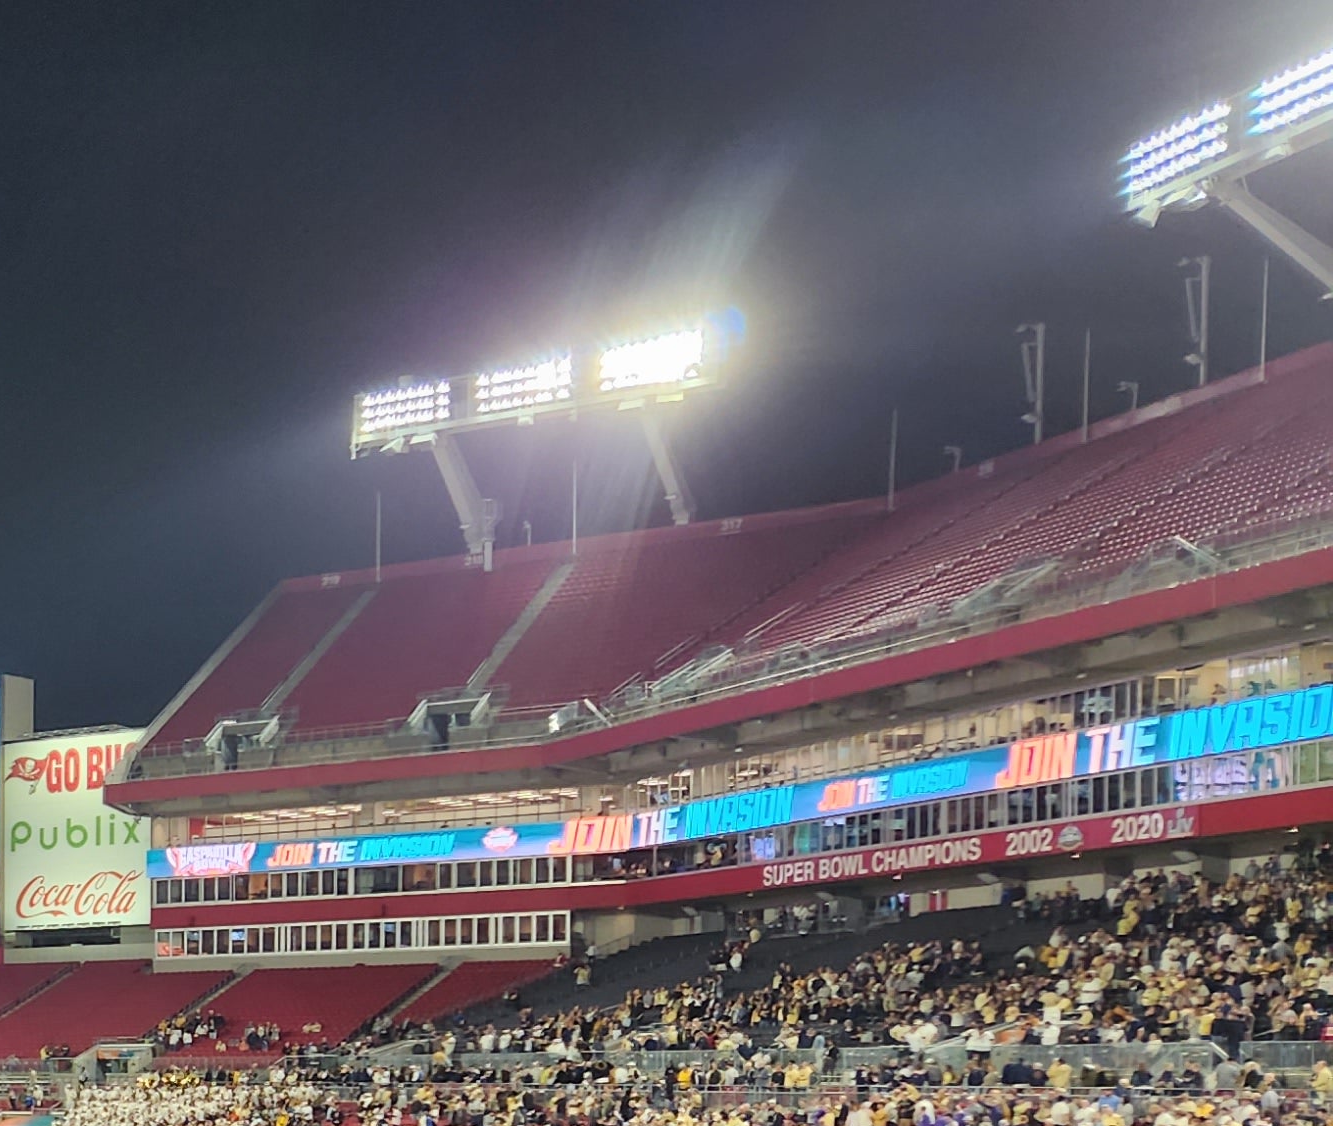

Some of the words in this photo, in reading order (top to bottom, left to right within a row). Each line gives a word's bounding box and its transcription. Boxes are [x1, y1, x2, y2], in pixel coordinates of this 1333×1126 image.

[46, 748, 79, 794] GO
[86, 742, 136, 790] BU
[996, 733, 1076, 788] JOIN
[1086, 716, 1161, 772] THE
[818, 782, 855, 811] JOIN
[858, 775, 889, 804] THE
[891, 761, 968, 799] INVASION
[11, 813, 141, 852] Publix
[549, 816, 634, 855] JOIN
[634, 806, 681, 848] THE
[685, 785, 796, 841] INVASION
[1005, 828, 1055, 857] 2002
[1111, 811, 1165, 842] 2020
[268, 843, 313, 867] JOIN
[318, 841, 357, 863] THE
[360, 833, 457, 861] INVASION
[762, 850, 815, 887] SUPER
[817, 847, 866, 882] BOWL
[871, 837, 982, 877] CHAMPIONS
[15, 869, 143, 919] Coca-Cola
